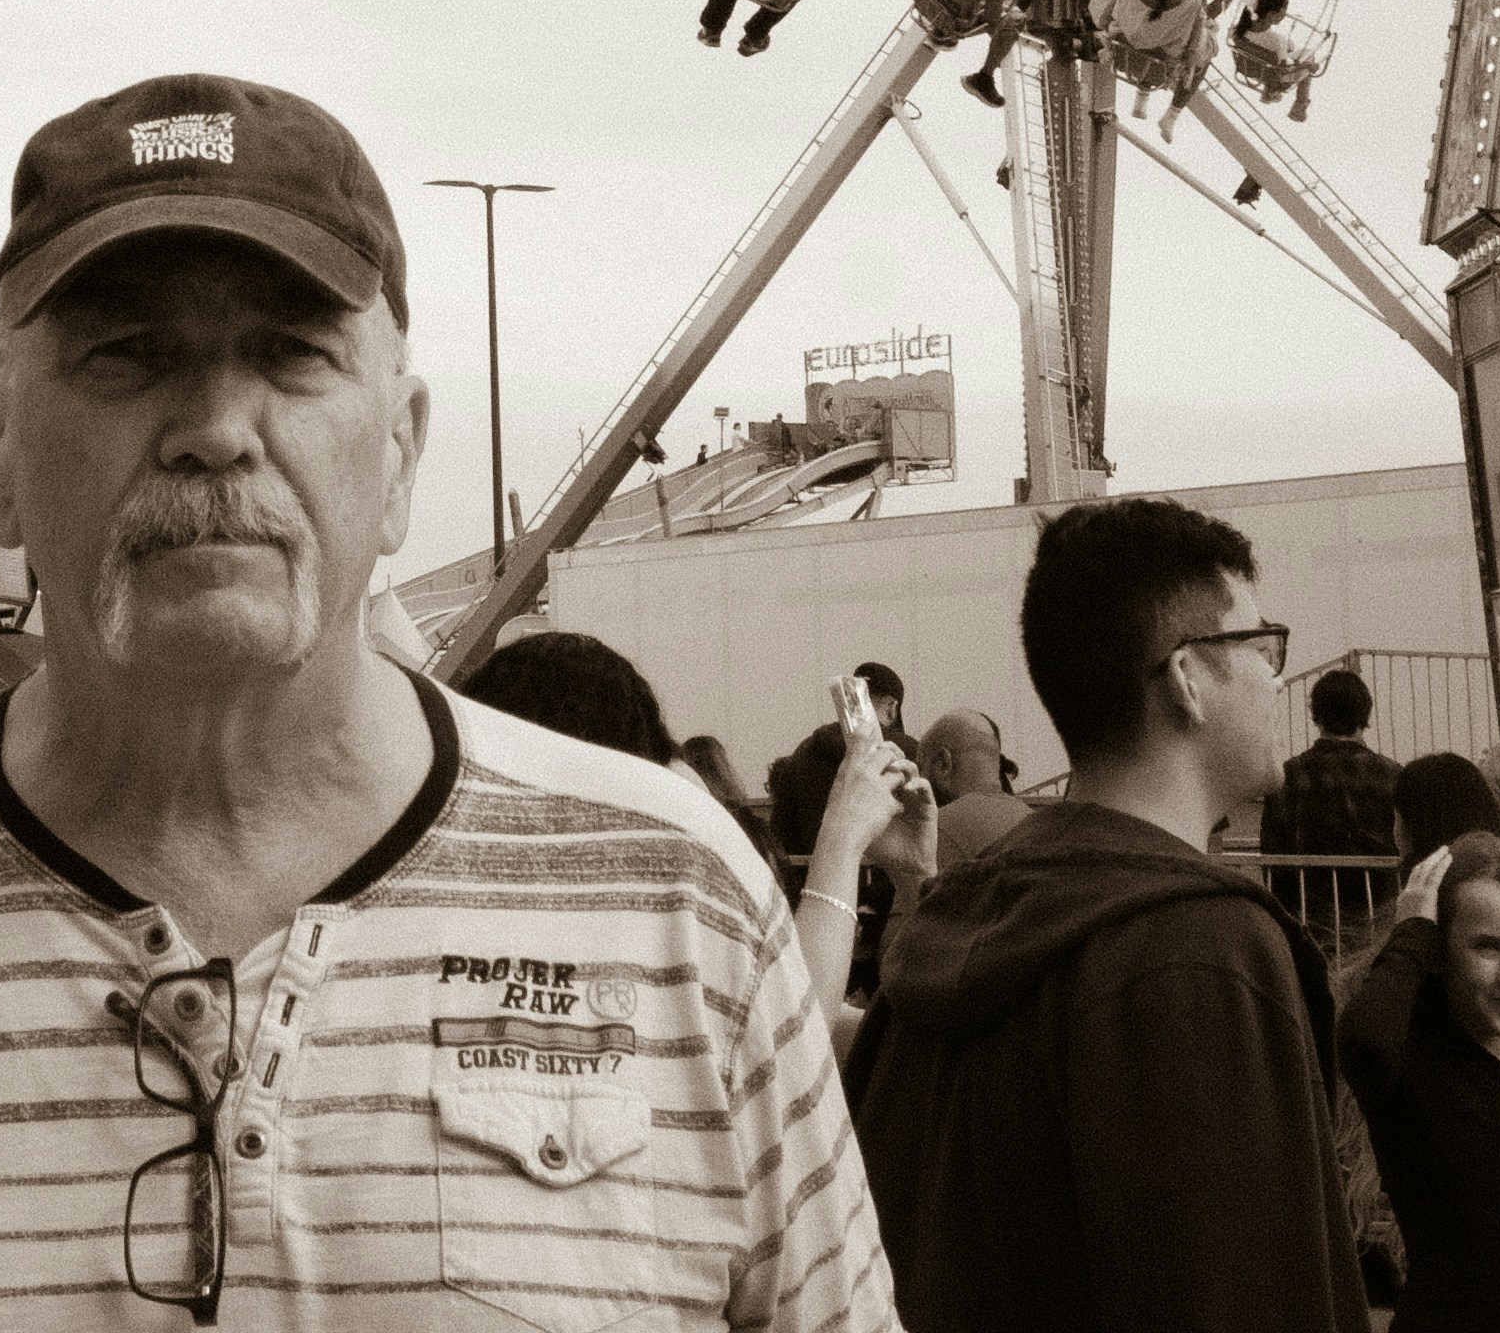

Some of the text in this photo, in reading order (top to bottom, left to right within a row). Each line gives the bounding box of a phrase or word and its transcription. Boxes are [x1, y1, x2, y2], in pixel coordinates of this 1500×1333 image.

[133, 141, 234, 166] THINGS
[499, 982, 579, 1016] RAW
[457, 1048, 622, 1075] COAST SIXTY 7
